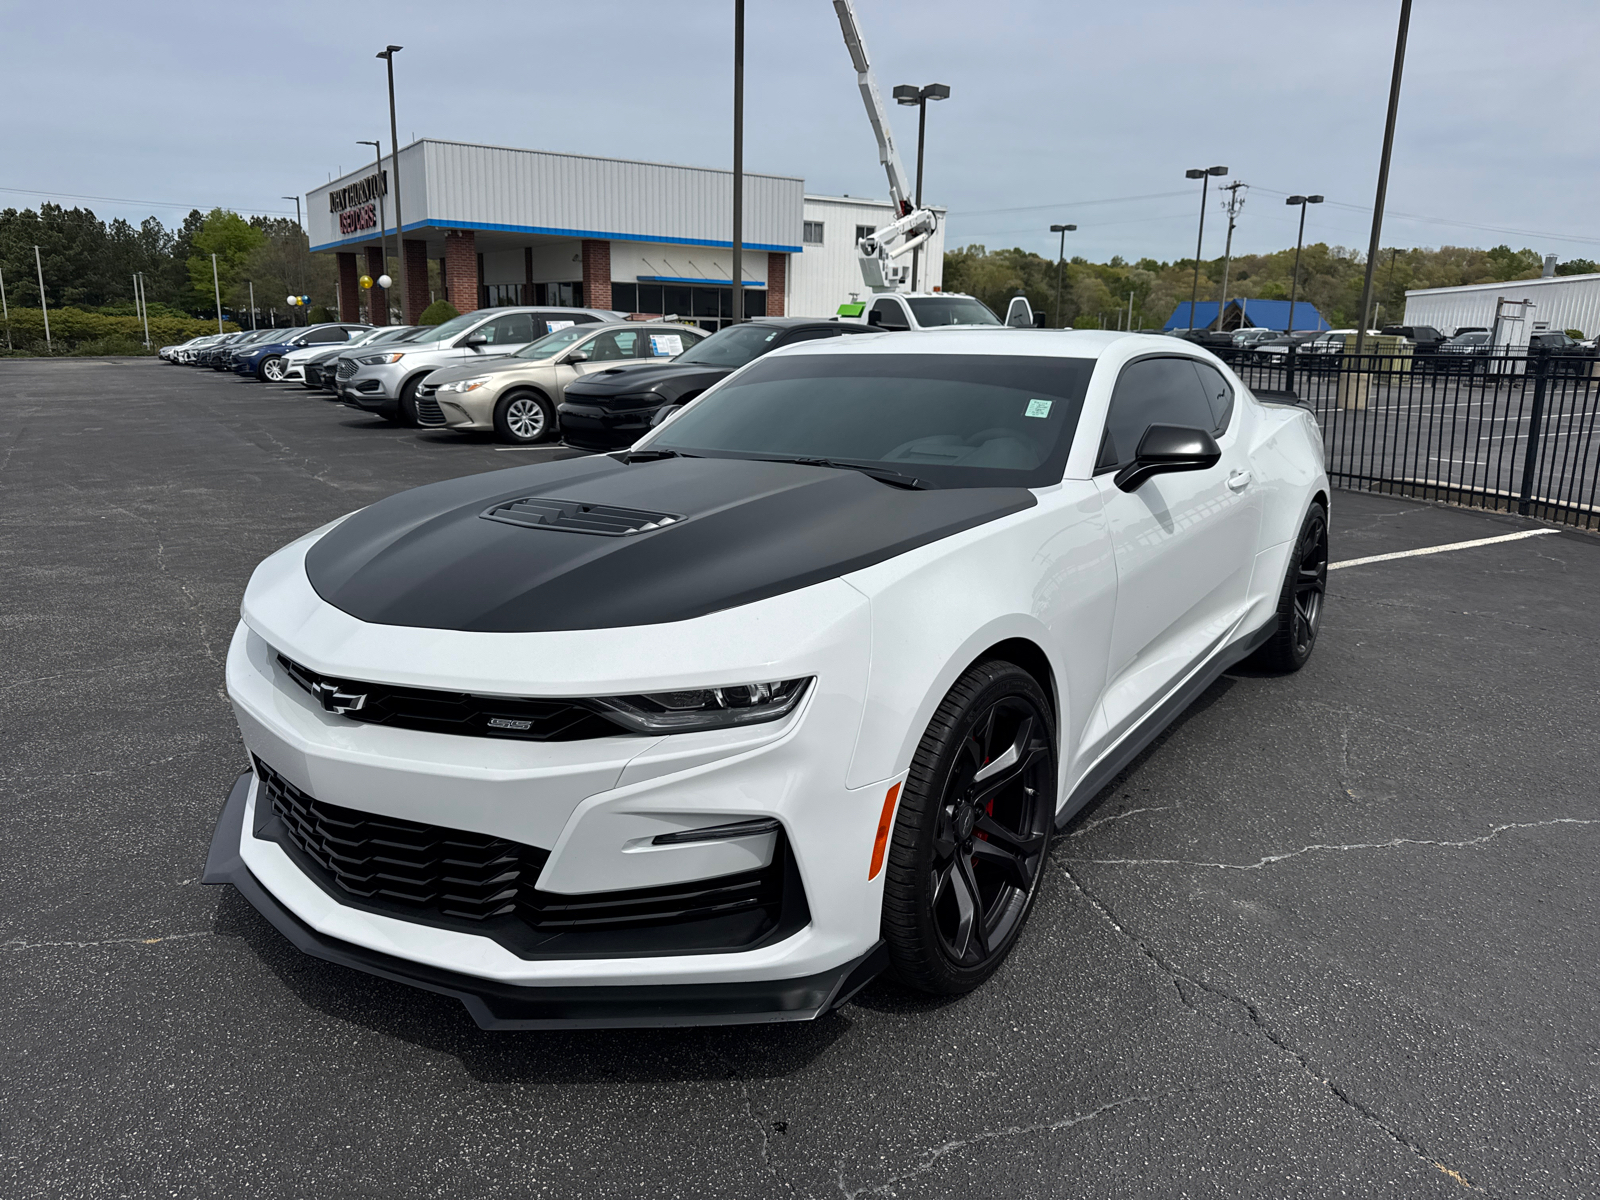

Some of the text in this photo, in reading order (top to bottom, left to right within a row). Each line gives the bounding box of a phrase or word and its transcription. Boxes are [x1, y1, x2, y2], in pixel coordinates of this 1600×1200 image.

[339, 203, 377, 234] USED CARS
[487, 718, 534, 730] SS
